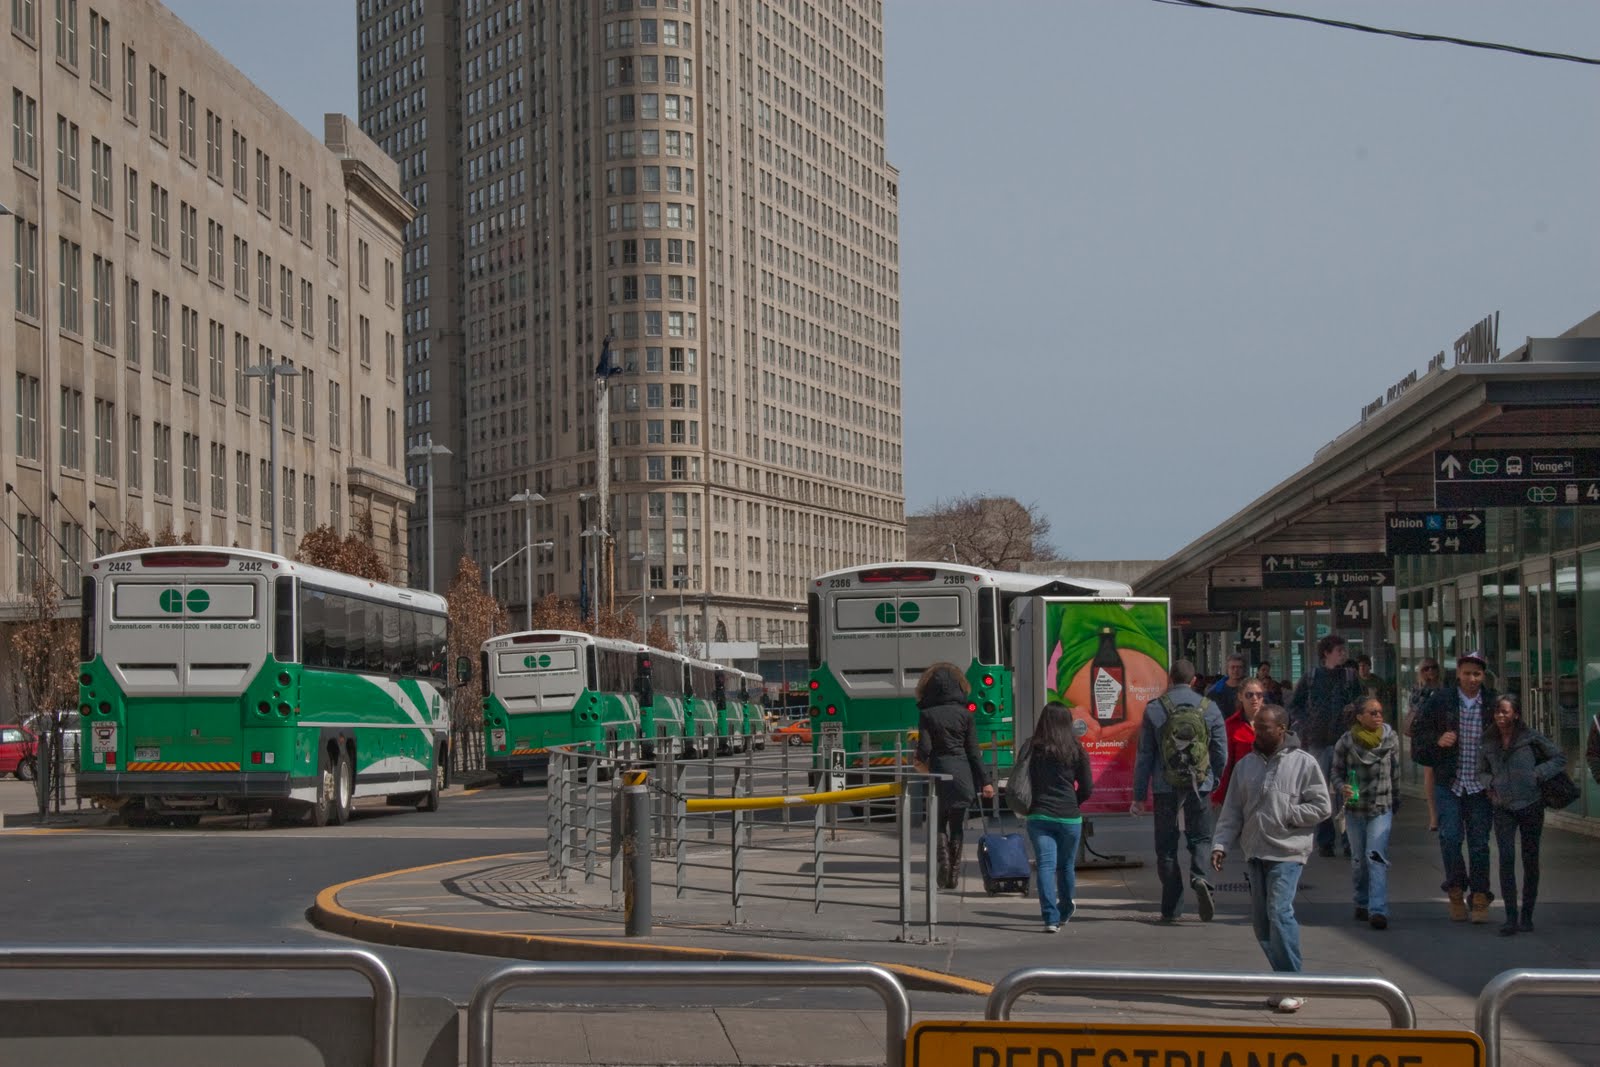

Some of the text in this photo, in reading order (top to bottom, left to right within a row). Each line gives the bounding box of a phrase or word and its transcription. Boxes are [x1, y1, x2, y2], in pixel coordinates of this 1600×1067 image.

[1533, 462, 1564, 473] Yonge
[1390, 517, 1424, 528] Union
[1428, 537, 1440, 552] 3
[109, 562, 132, 572] 2442
[239, 562, 262, 572] 2442
[830, 579, 851, 588] 2366
[944, 575, 965, 585] 2366
[1314, 573, 1323, 585] 3
[1343, 573, 1369, 583] Union
[1343, 599, 1369, 619] 41
[109, 624, 152, 632] gotransit.com
